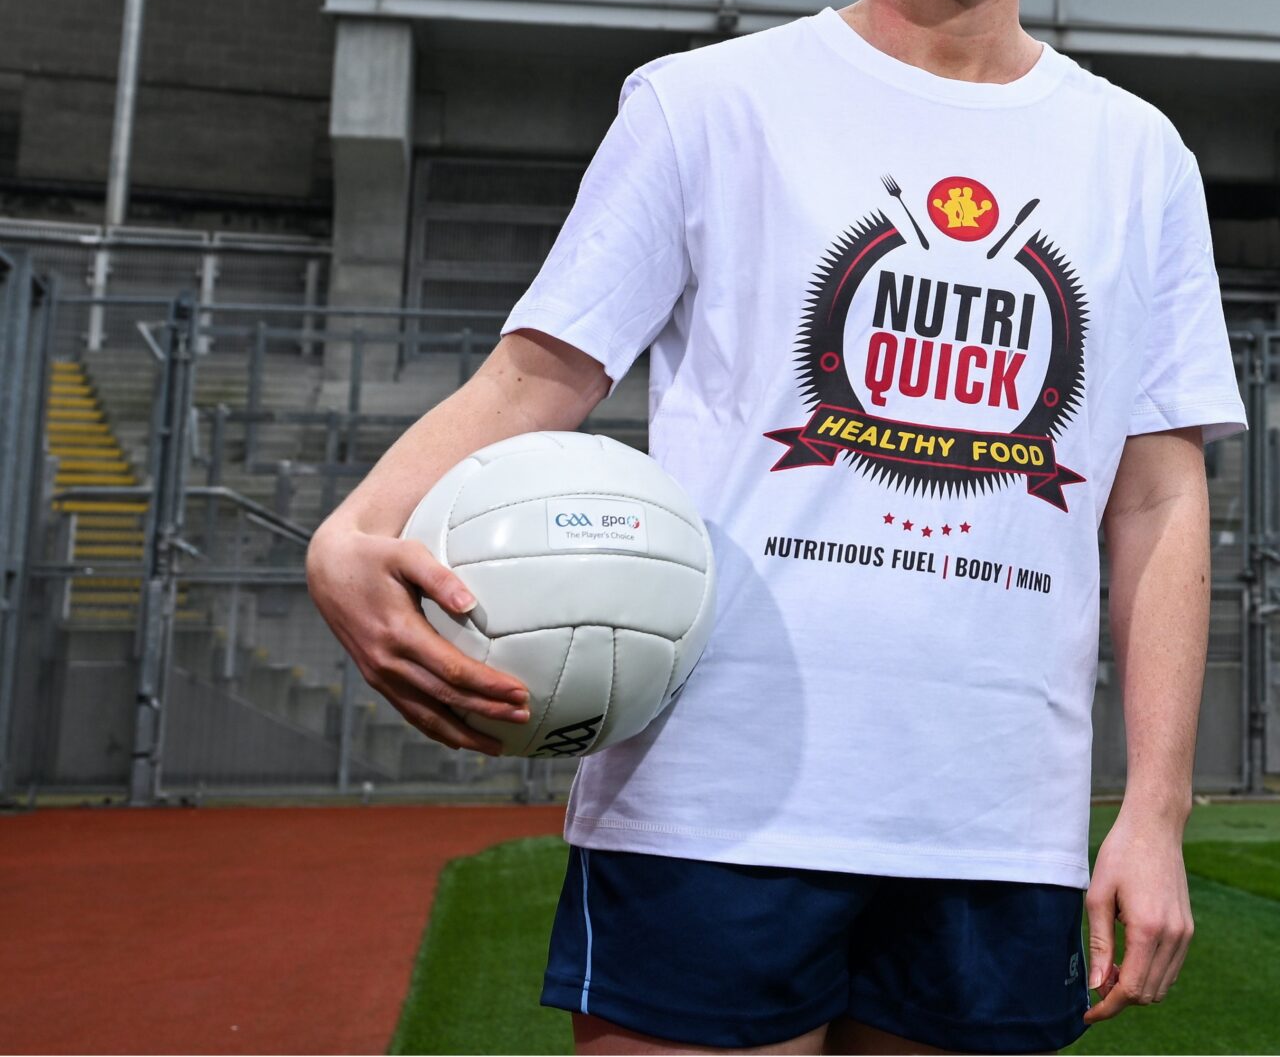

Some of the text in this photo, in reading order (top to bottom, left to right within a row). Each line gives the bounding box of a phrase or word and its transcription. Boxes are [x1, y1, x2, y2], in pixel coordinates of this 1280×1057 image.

[872, 270, 1036, 351] NUTRI
[864, 331, 1027, 411] QUICK
[817, 416, 1044, 466] HEALTHY FOOD
[555, 512, 626, 527] GAA gpa
[566, 531, 635, 541] The Player's Choice
[764, 536, 1052, 594] NUTRITIOUS FUEL BODY MIND
